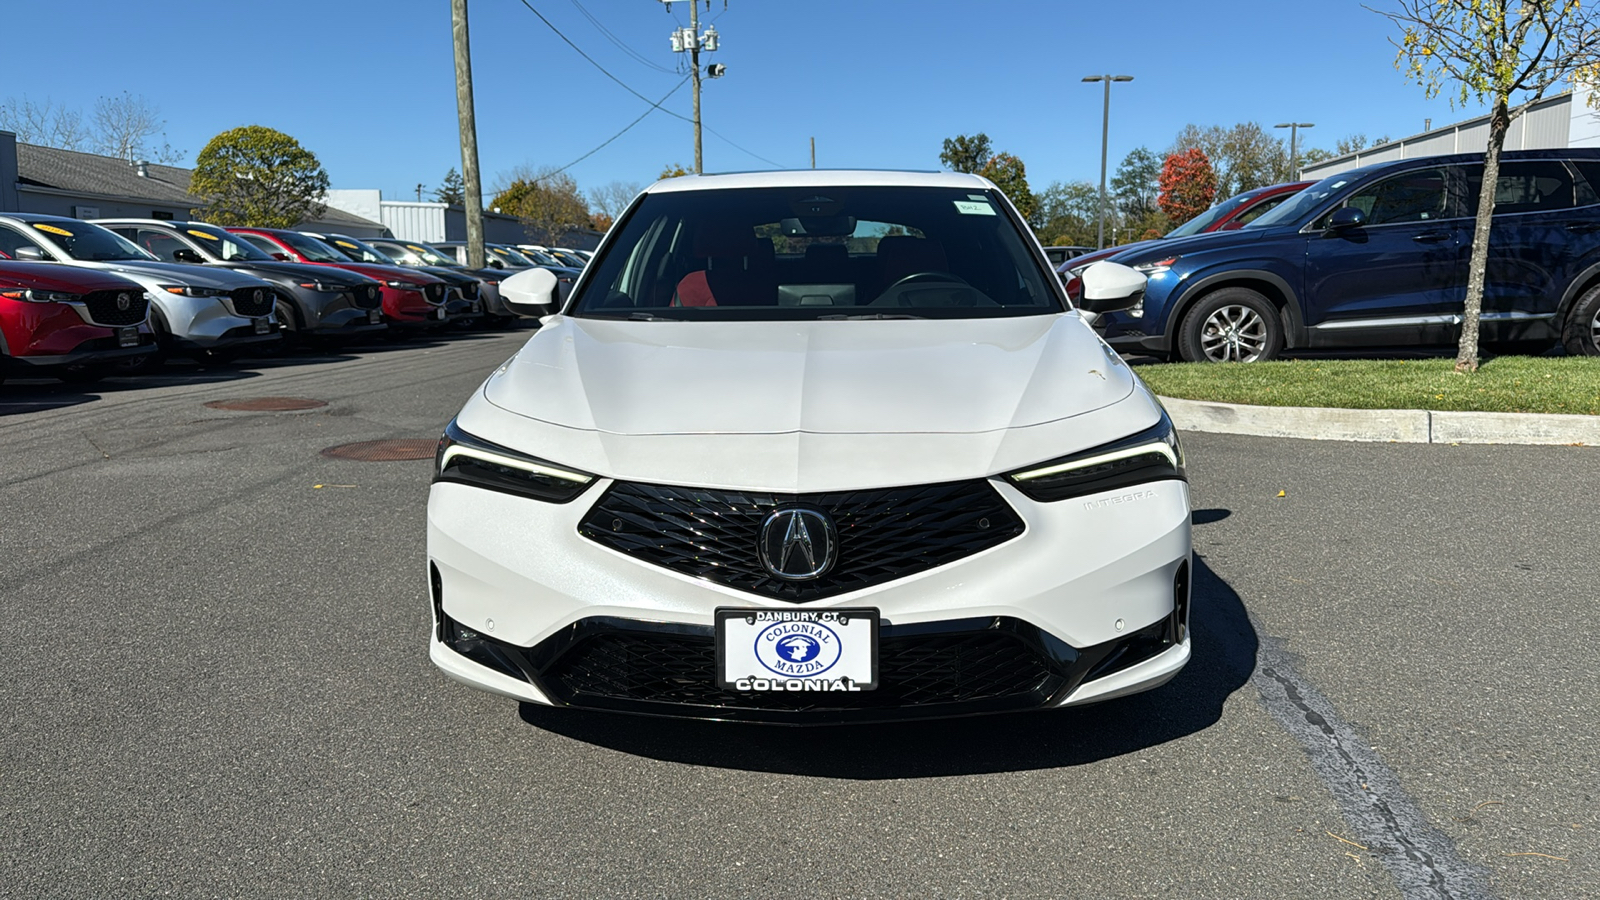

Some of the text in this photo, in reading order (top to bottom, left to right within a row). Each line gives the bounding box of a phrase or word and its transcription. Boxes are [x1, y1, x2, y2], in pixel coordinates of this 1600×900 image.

[1083, 490, 1158, 511] INTEGRA
[756, 612, 839, 622] DANBURY, CT
[765, 623, 830, 644] COLONIAL
[774, 660, 824, 674] MAZDA
[735, 679, 861, 691] COLONIAL
